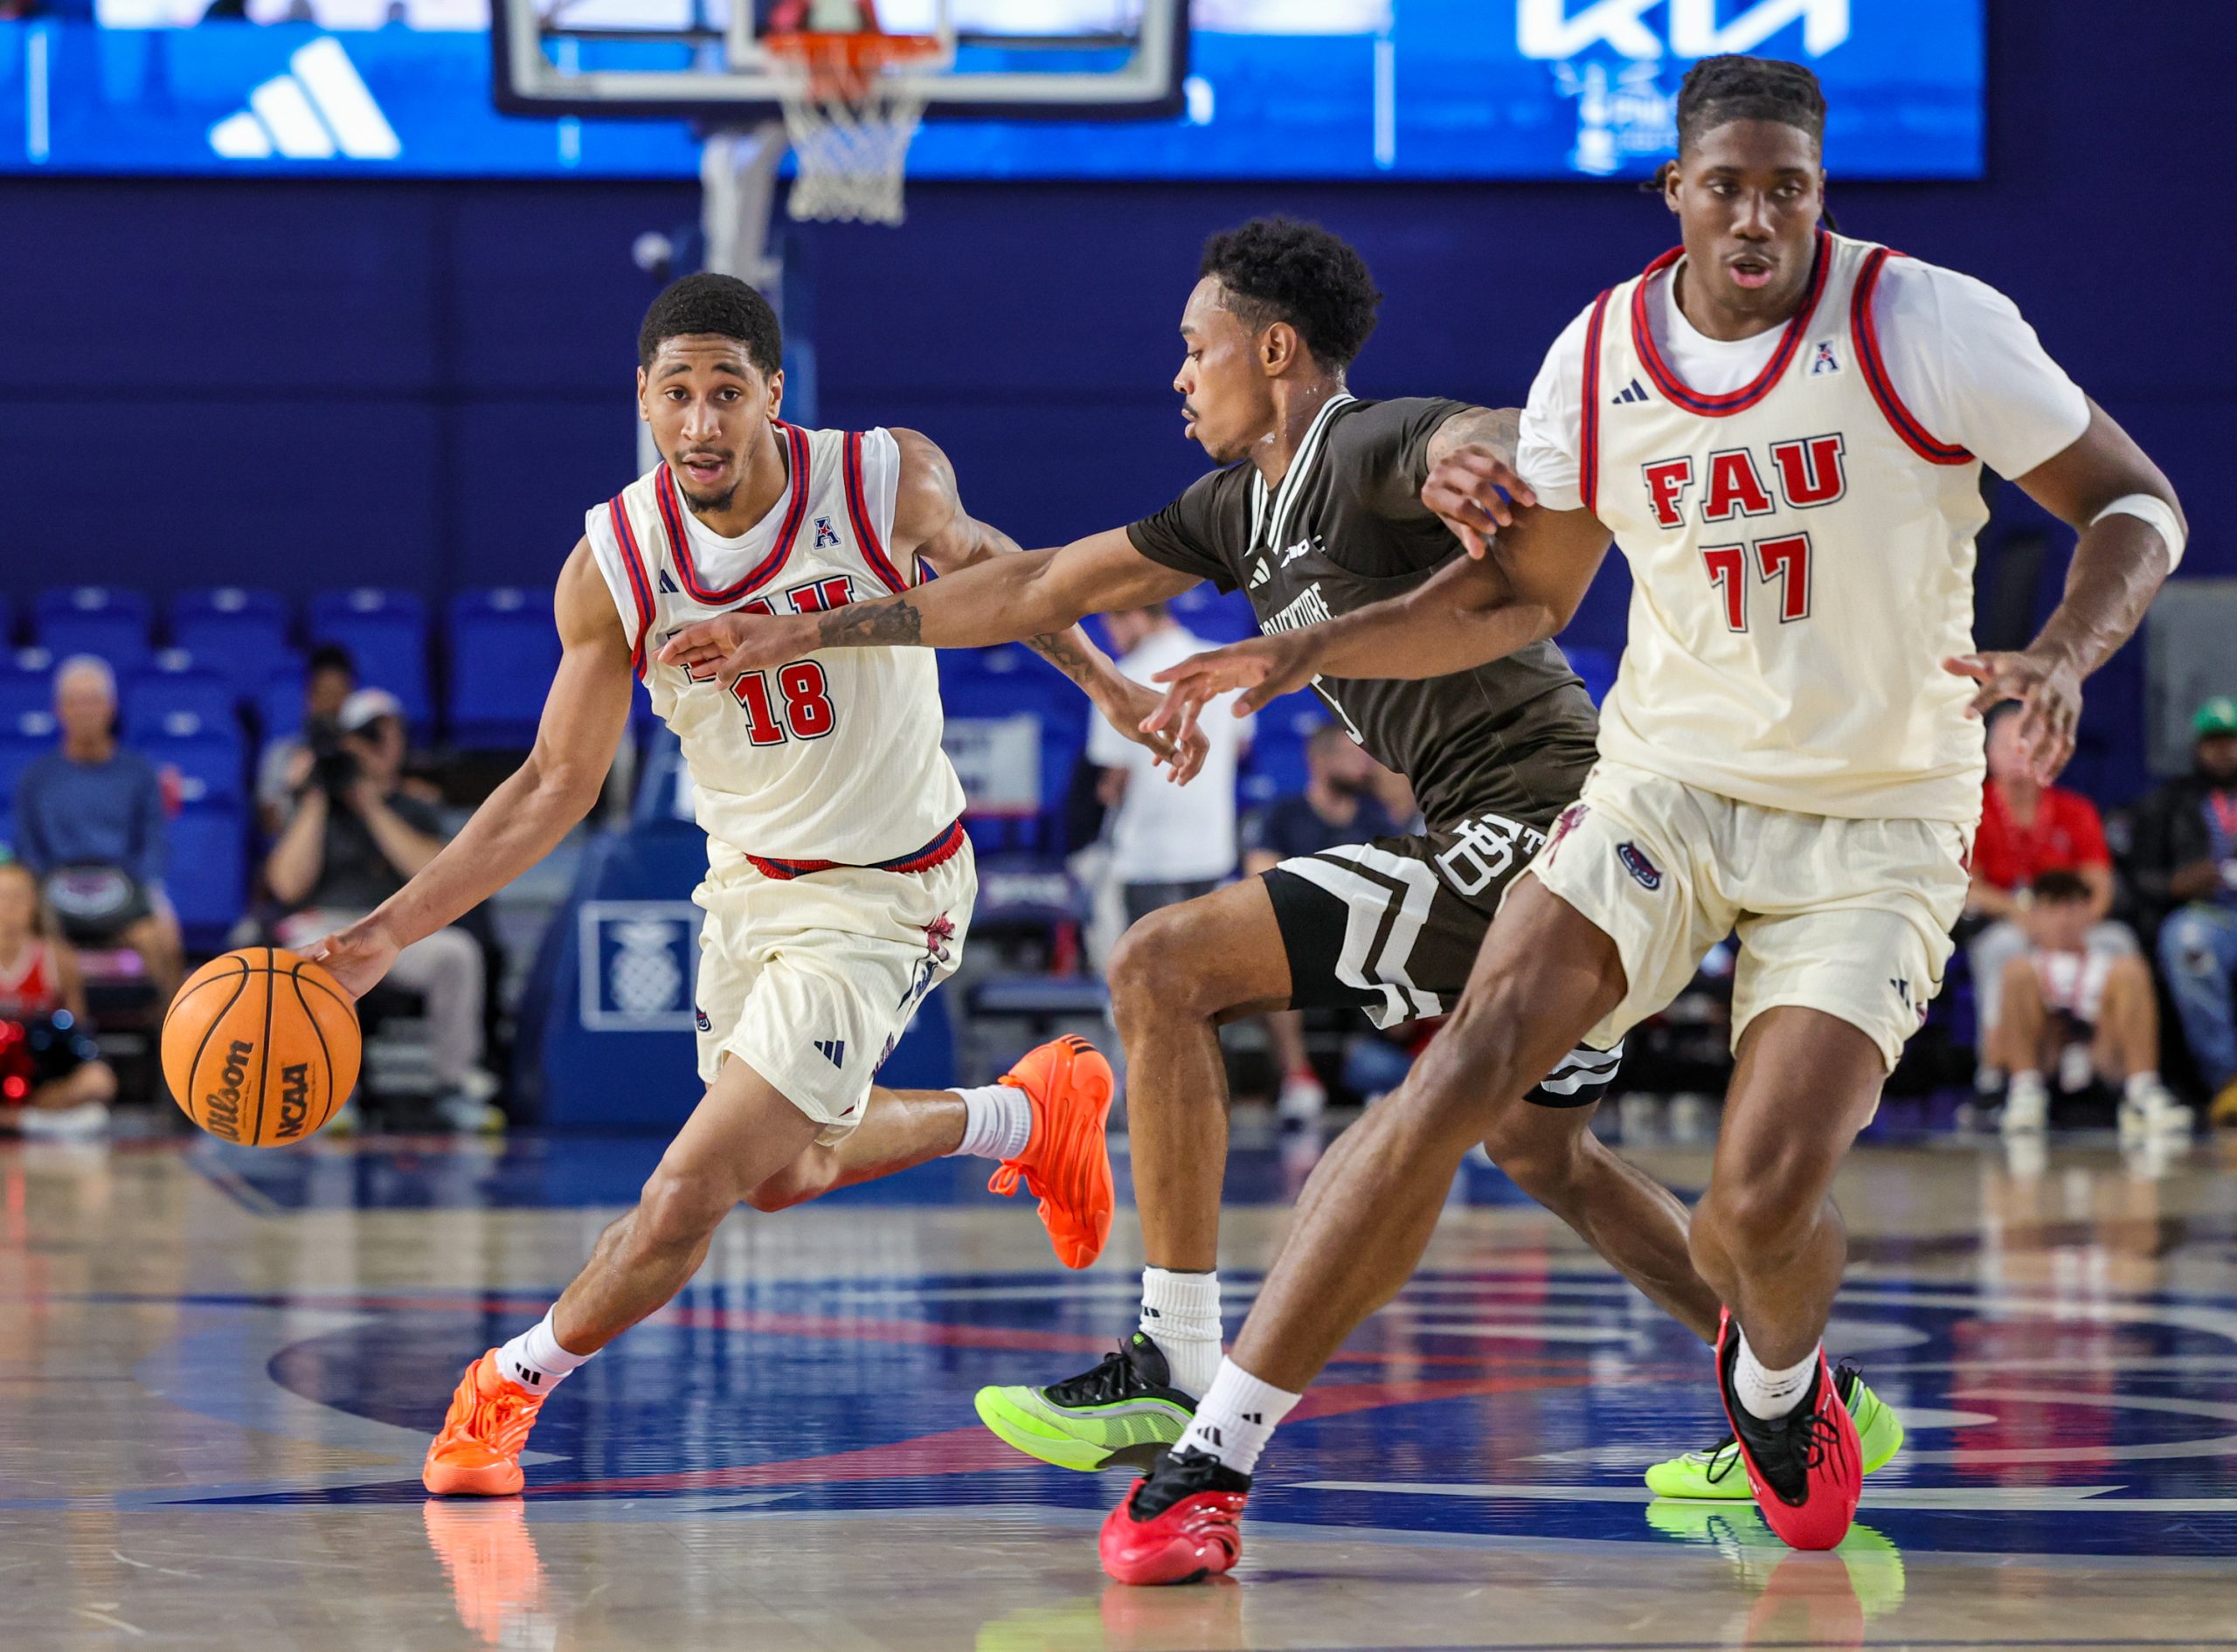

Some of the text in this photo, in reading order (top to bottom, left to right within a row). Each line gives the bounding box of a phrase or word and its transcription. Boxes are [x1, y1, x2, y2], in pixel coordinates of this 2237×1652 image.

[1641, 432, 1846, 529] FAU
[1699, 531, 1811, 633] 77
[730, 659, 836, 747] 18
[205, 1040, 254, 1143] Wilson
[275, 1062, 308, 1138] NCAA
